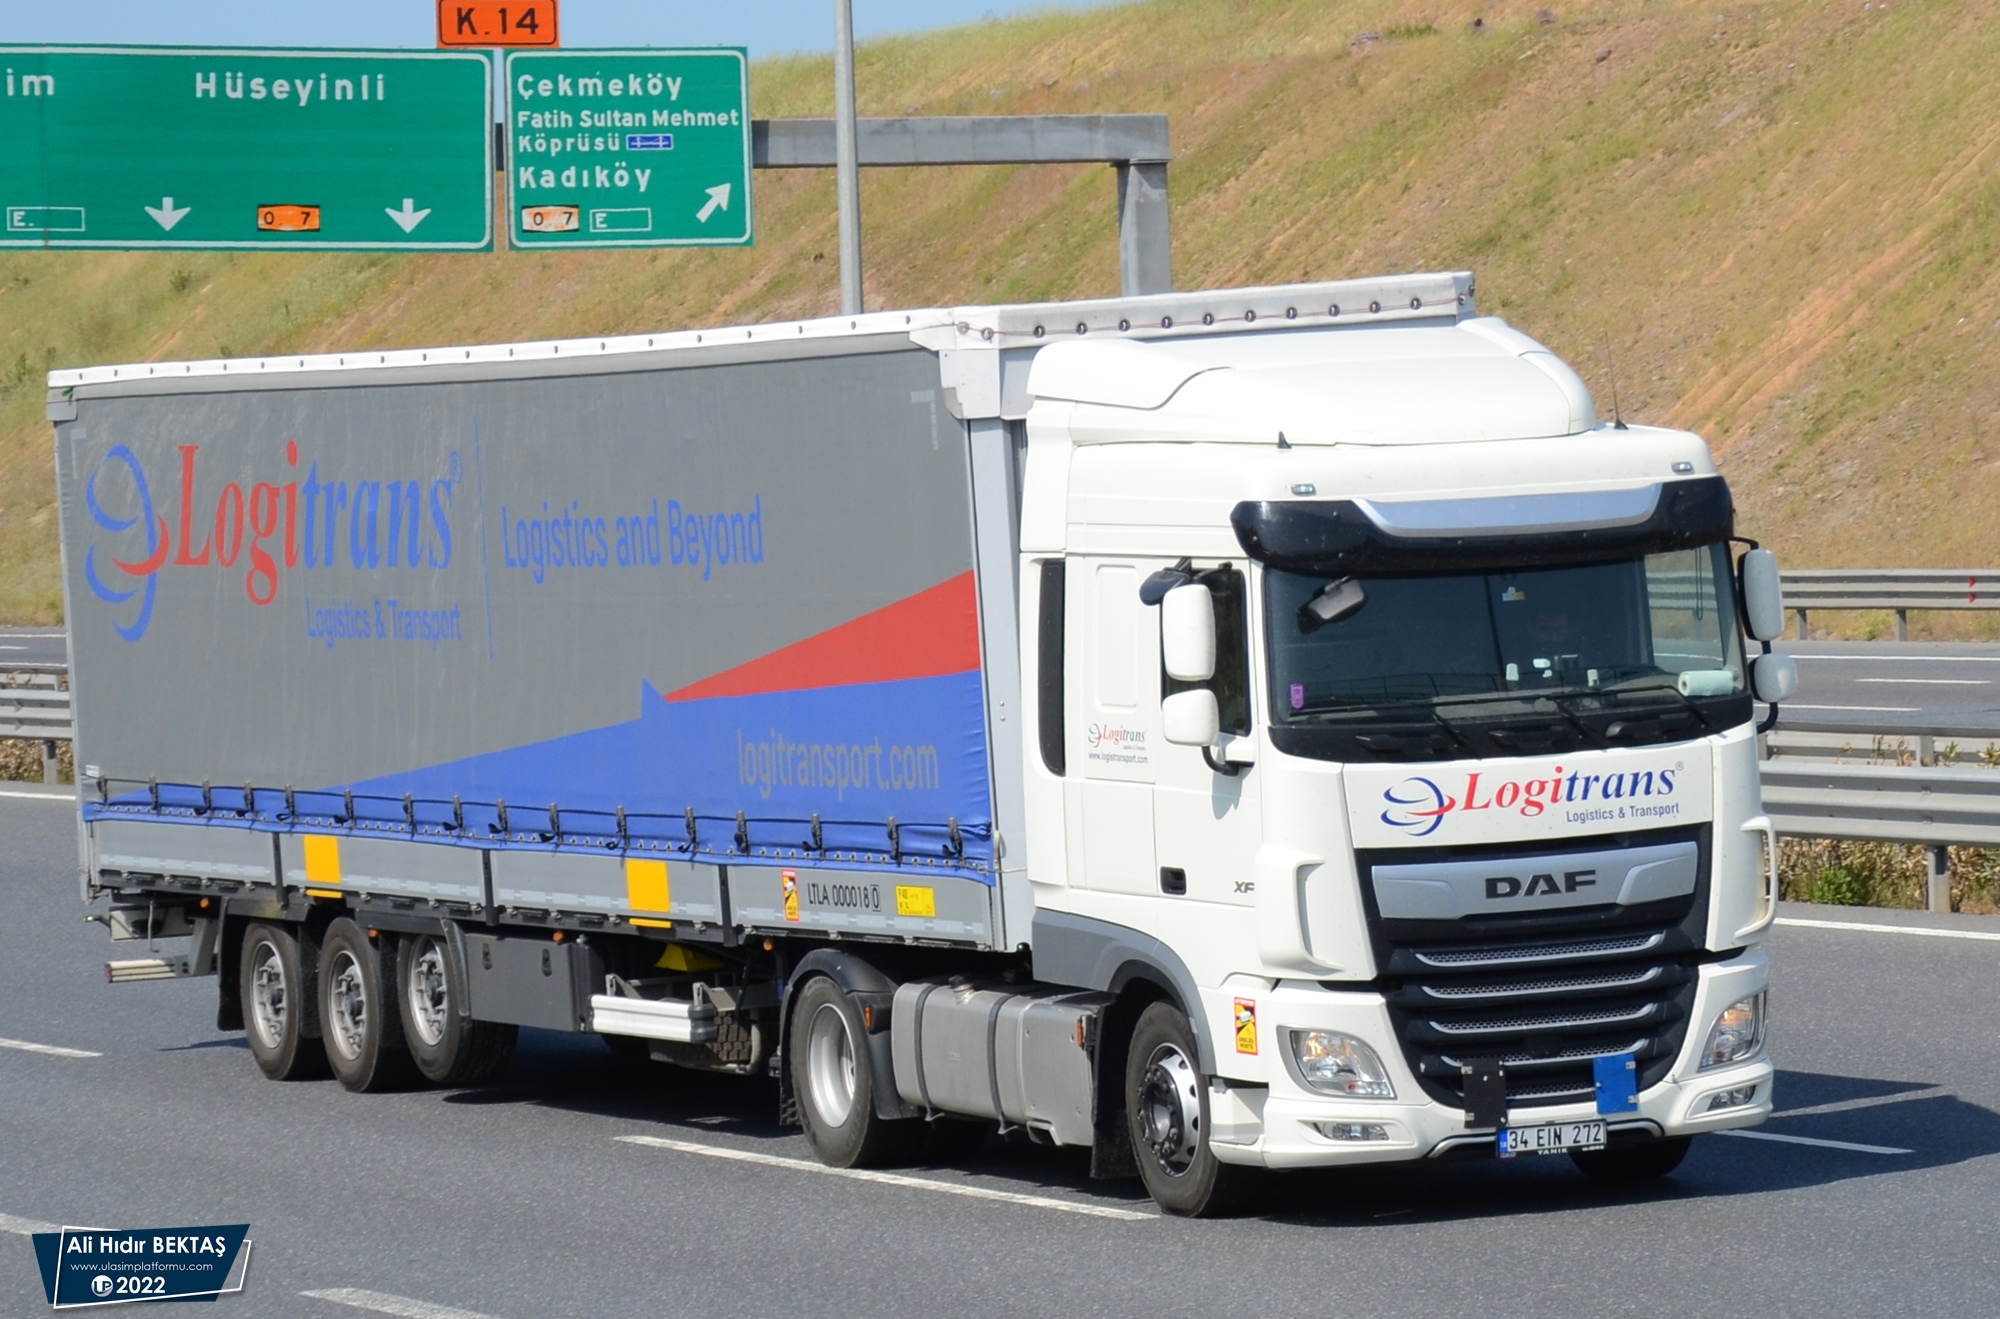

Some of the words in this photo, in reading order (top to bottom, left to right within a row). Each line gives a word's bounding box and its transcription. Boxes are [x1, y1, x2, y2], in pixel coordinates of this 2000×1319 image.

[456, 7, 539, 36] K.14
[195, 71, 385, 107] Hüseyinli
[517, 72, 683, 101] Çekmeköy
[517, 110, 573, 129] Fatih
[579, 109, 648, 128] Sultan
[652, 109, 740, 127] Mehmet
[518, 133, 621, 157] Köprüsü
[519, 162, 652, 192] Kadıköy
[502, 501, 609, 585] Logistics
[615, 498, 662, 567] and
[667, 494, 764, 582] Beyond
[305, 597, 372, 650] Logistics
[374, 598, 387, 640] &
[387, 598, 463, 653] Transport
[736, 727, 940, 802] logitransport.com
[1566, 808, 1614, 824] Logistics
[1617, 807, 1626, 820] &
[1629, 801, 1680, 819] Transport
[808, 883, 830, 906] LTLA
[832, 884, 870, 909] 000018
[1233, 880, 1256, 894] XF
[1484, 869, 1597, 900] DAF
[1509, 1131, 1529, 1149] 34
[1536, 1127, 1562, 1148] EIN
[1573, 1124, 1601, 1144] 272
